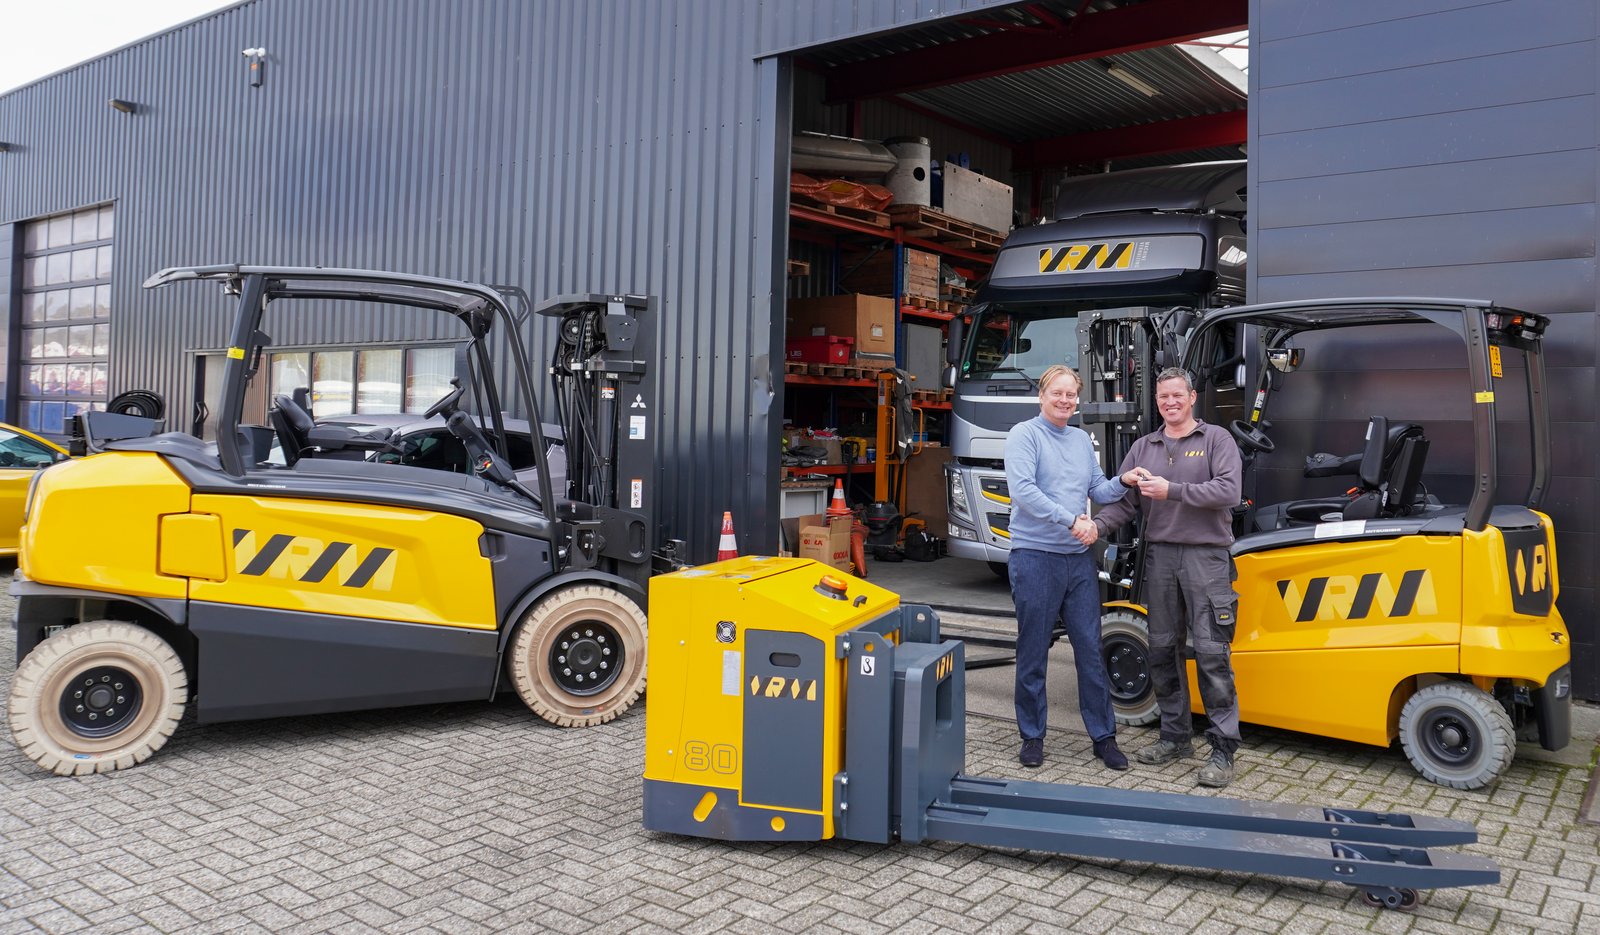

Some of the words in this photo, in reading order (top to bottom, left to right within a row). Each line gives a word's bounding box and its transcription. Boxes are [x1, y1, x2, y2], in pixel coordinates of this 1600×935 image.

[1039, 242, 1135, 274] VRM
[232, 528, 398, 592] VRM
[1276, 568, 1438, 622] VRM
[749, 675, 817, 701] VRM
[684, 740, 738, 775] 80
